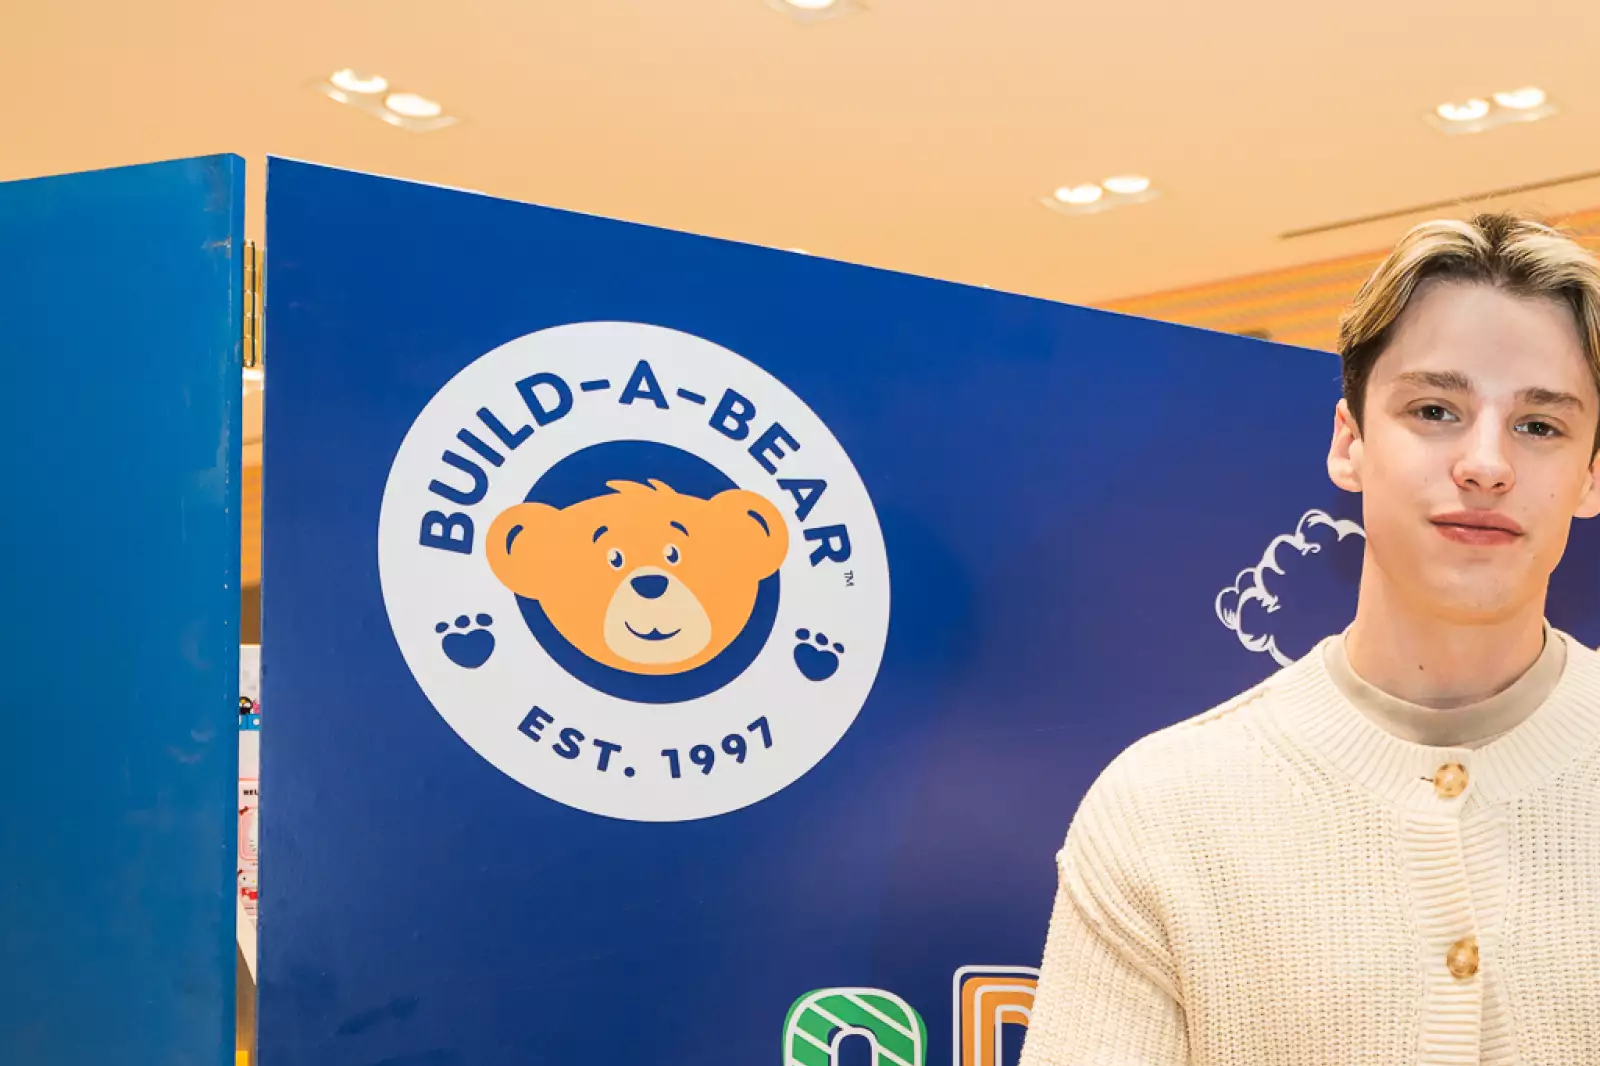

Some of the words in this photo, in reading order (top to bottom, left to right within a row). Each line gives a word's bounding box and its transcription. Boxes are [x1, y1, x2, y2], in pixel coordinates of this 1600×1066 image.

[418, 359, 852, 567] BUILD-A-BEAR
[517, 706, 635, 777] EST.
[661, 716, 774, 778] 1997
